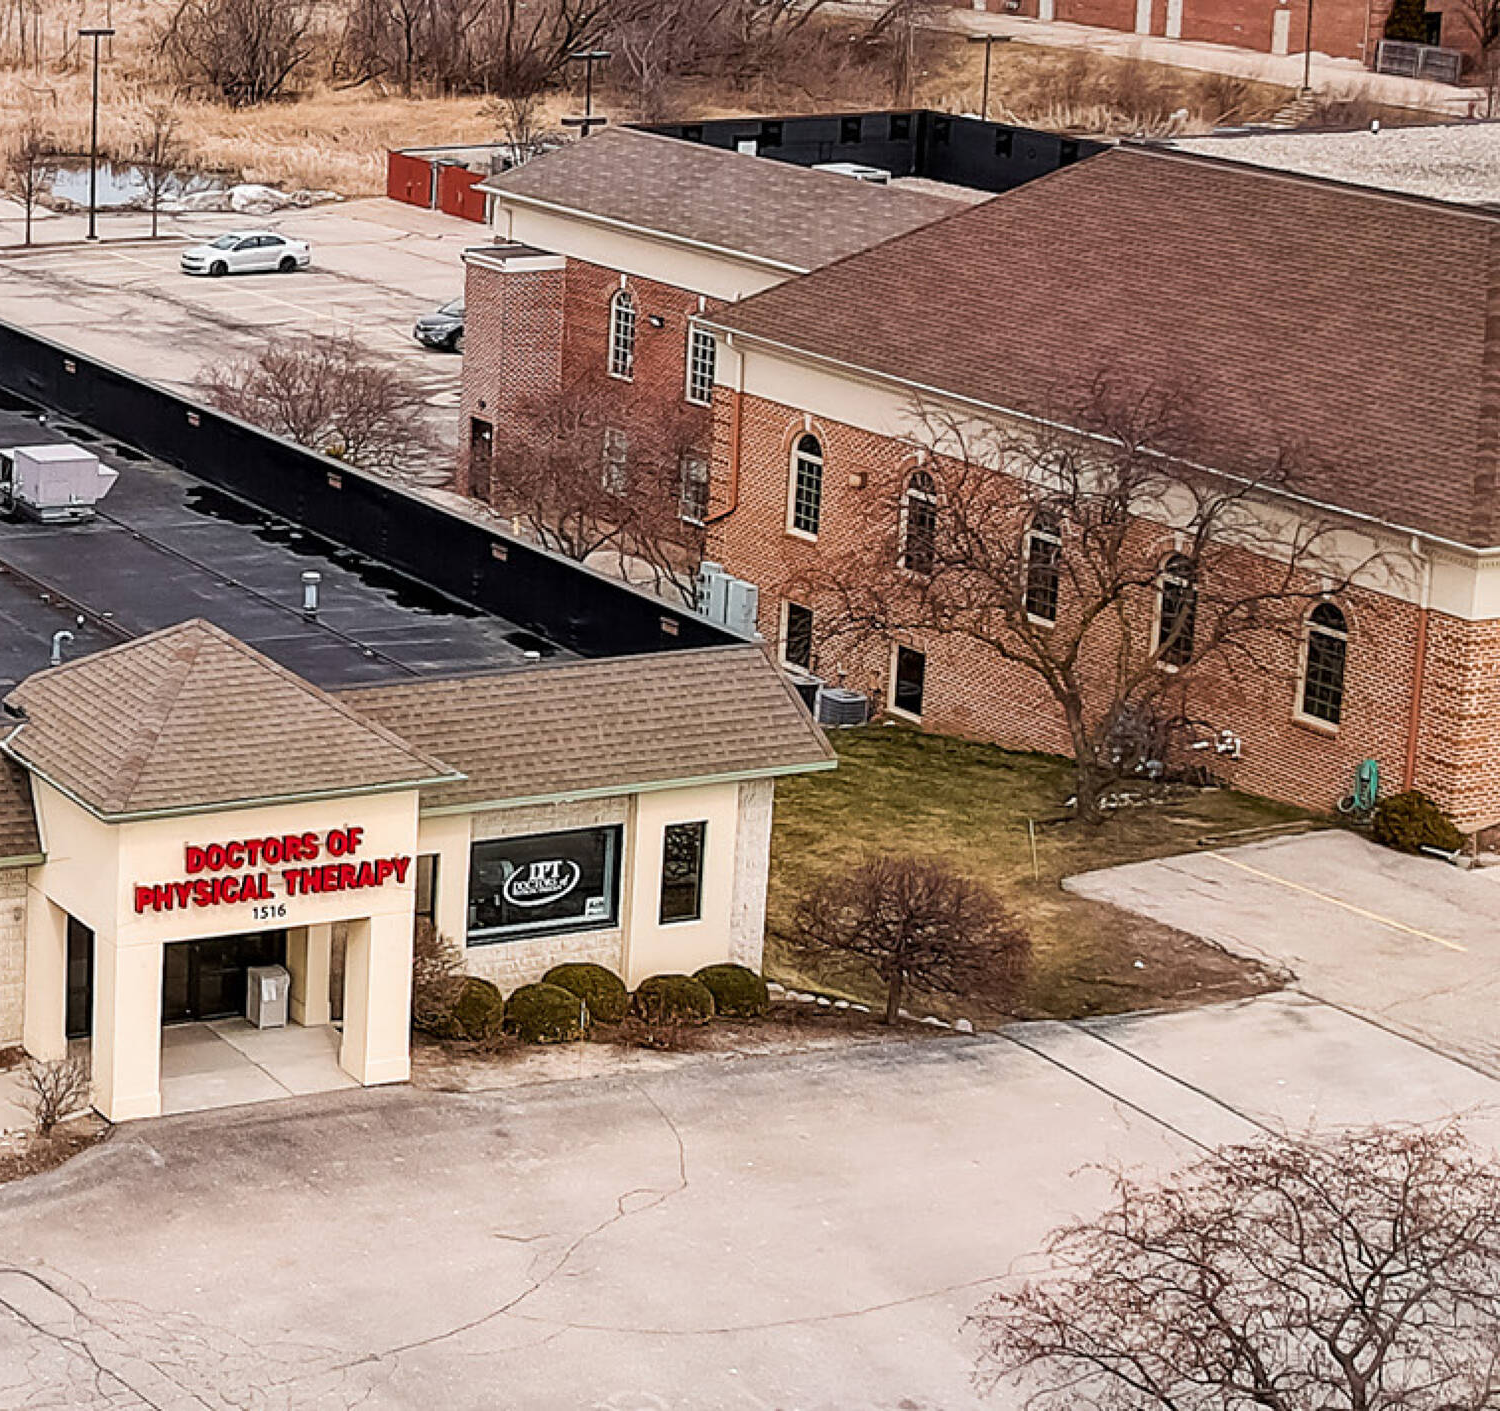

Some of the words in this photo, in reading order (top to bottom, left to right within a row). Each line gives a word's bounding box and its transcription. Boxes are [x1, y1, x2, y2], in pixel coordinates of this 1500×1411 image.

[185, 832, 319, 874] DOCTORS
[325, 827, 364, 857] OF
[134, 869, 274, 914] PHYSICAL
[282, 856, 411, 896] THERAPY
[252, 904, 287, 920] 1516
